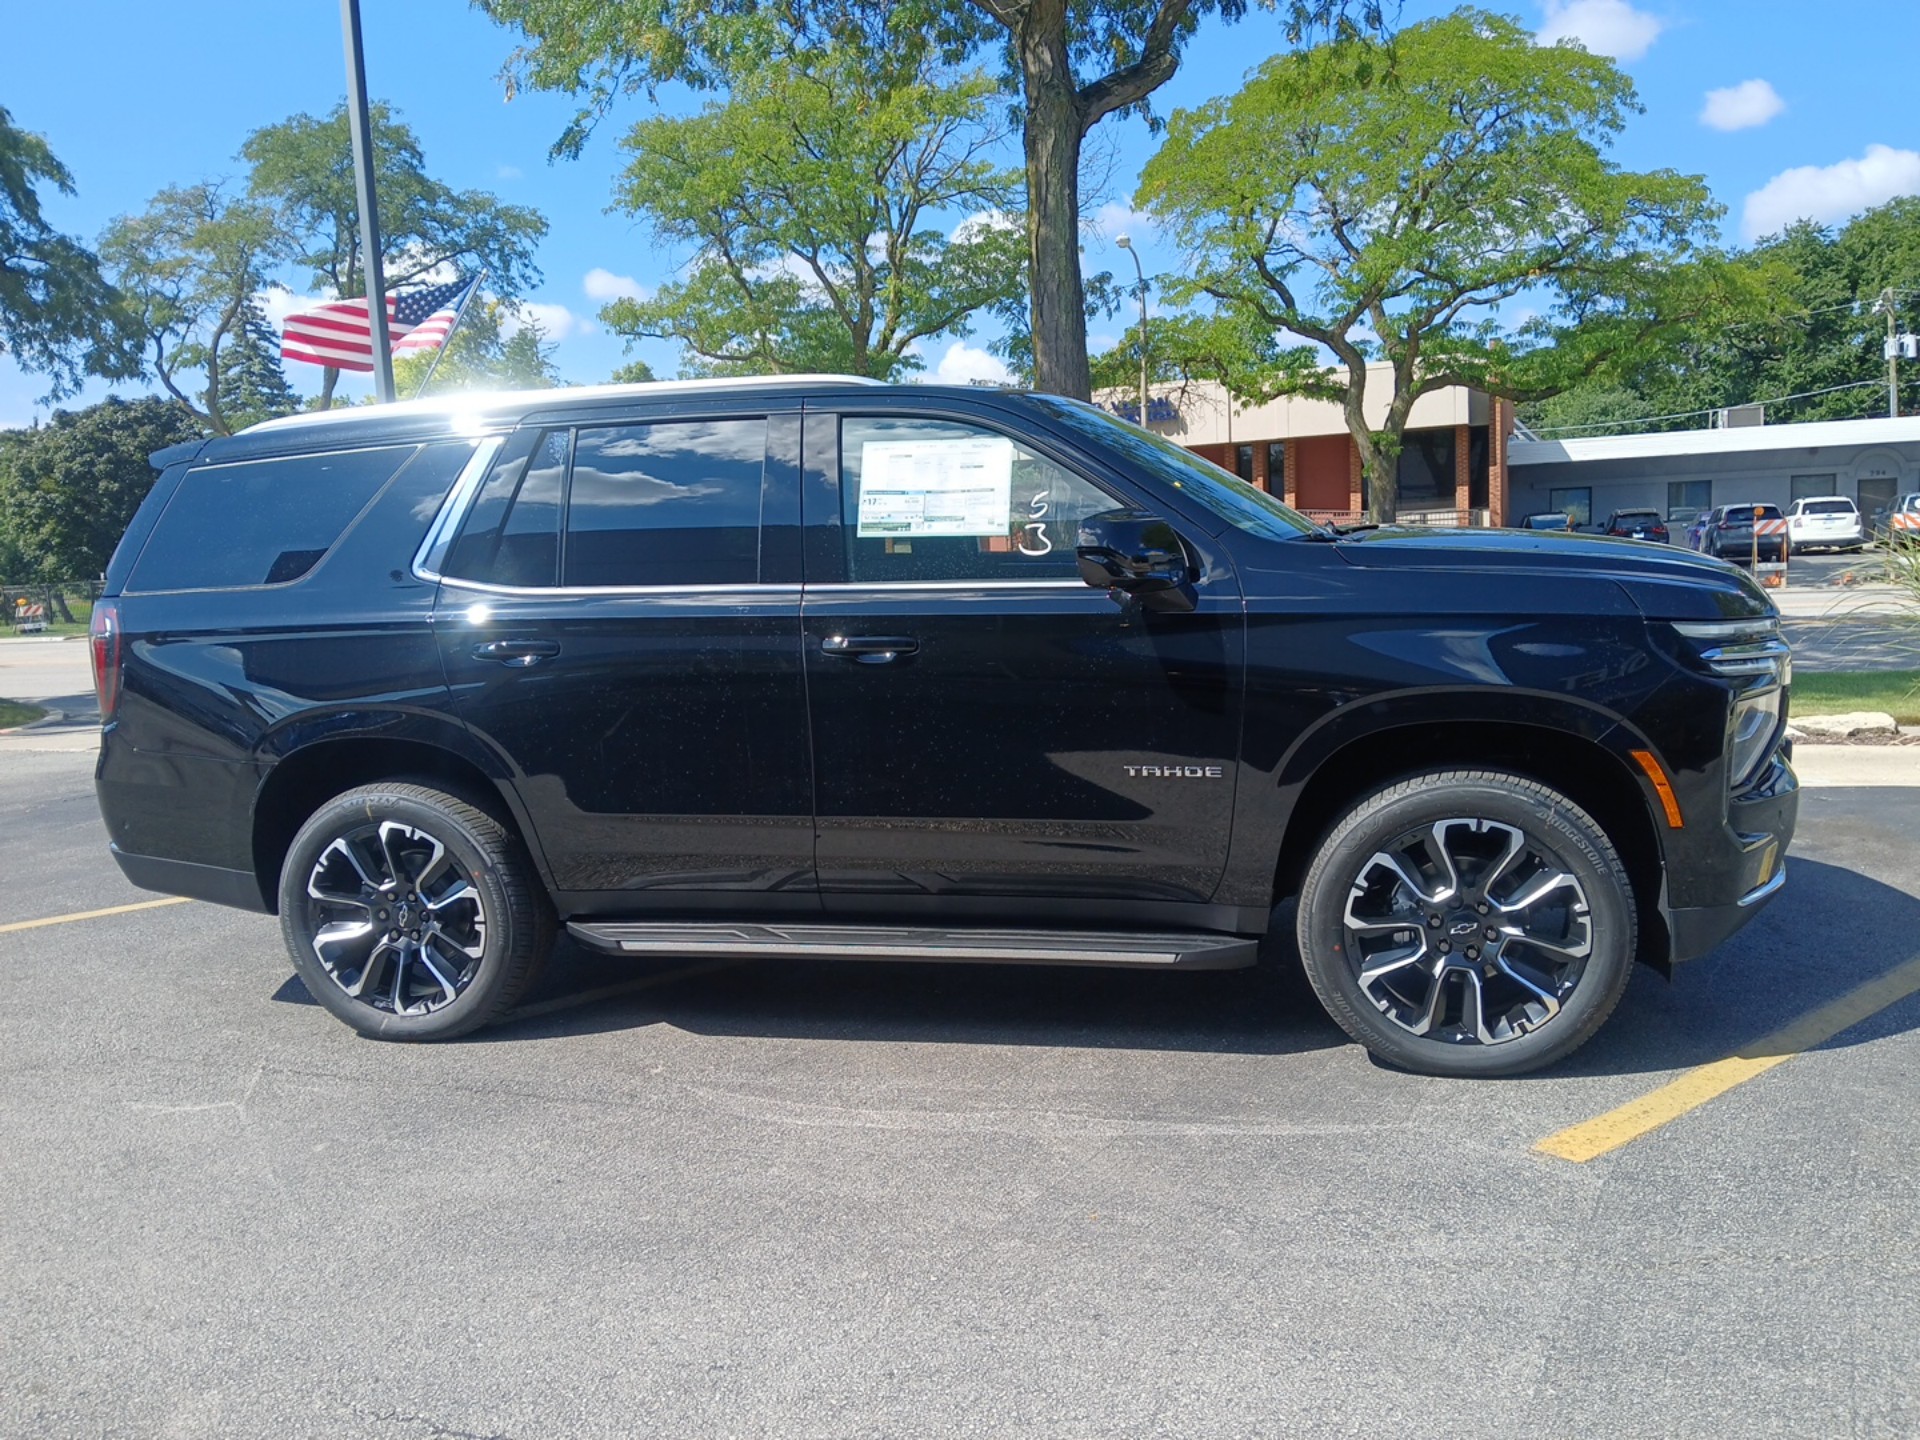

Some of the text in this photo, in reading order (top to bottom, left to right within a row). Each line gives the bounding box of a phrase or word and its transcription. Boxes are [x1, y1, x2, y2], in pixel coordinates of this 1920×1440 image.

[1018, 523, 1052, 556] 3
[1124, 765, 1222, 778] TAHOE
[1535, 808, 1609, 875] BRIDGESTONE
